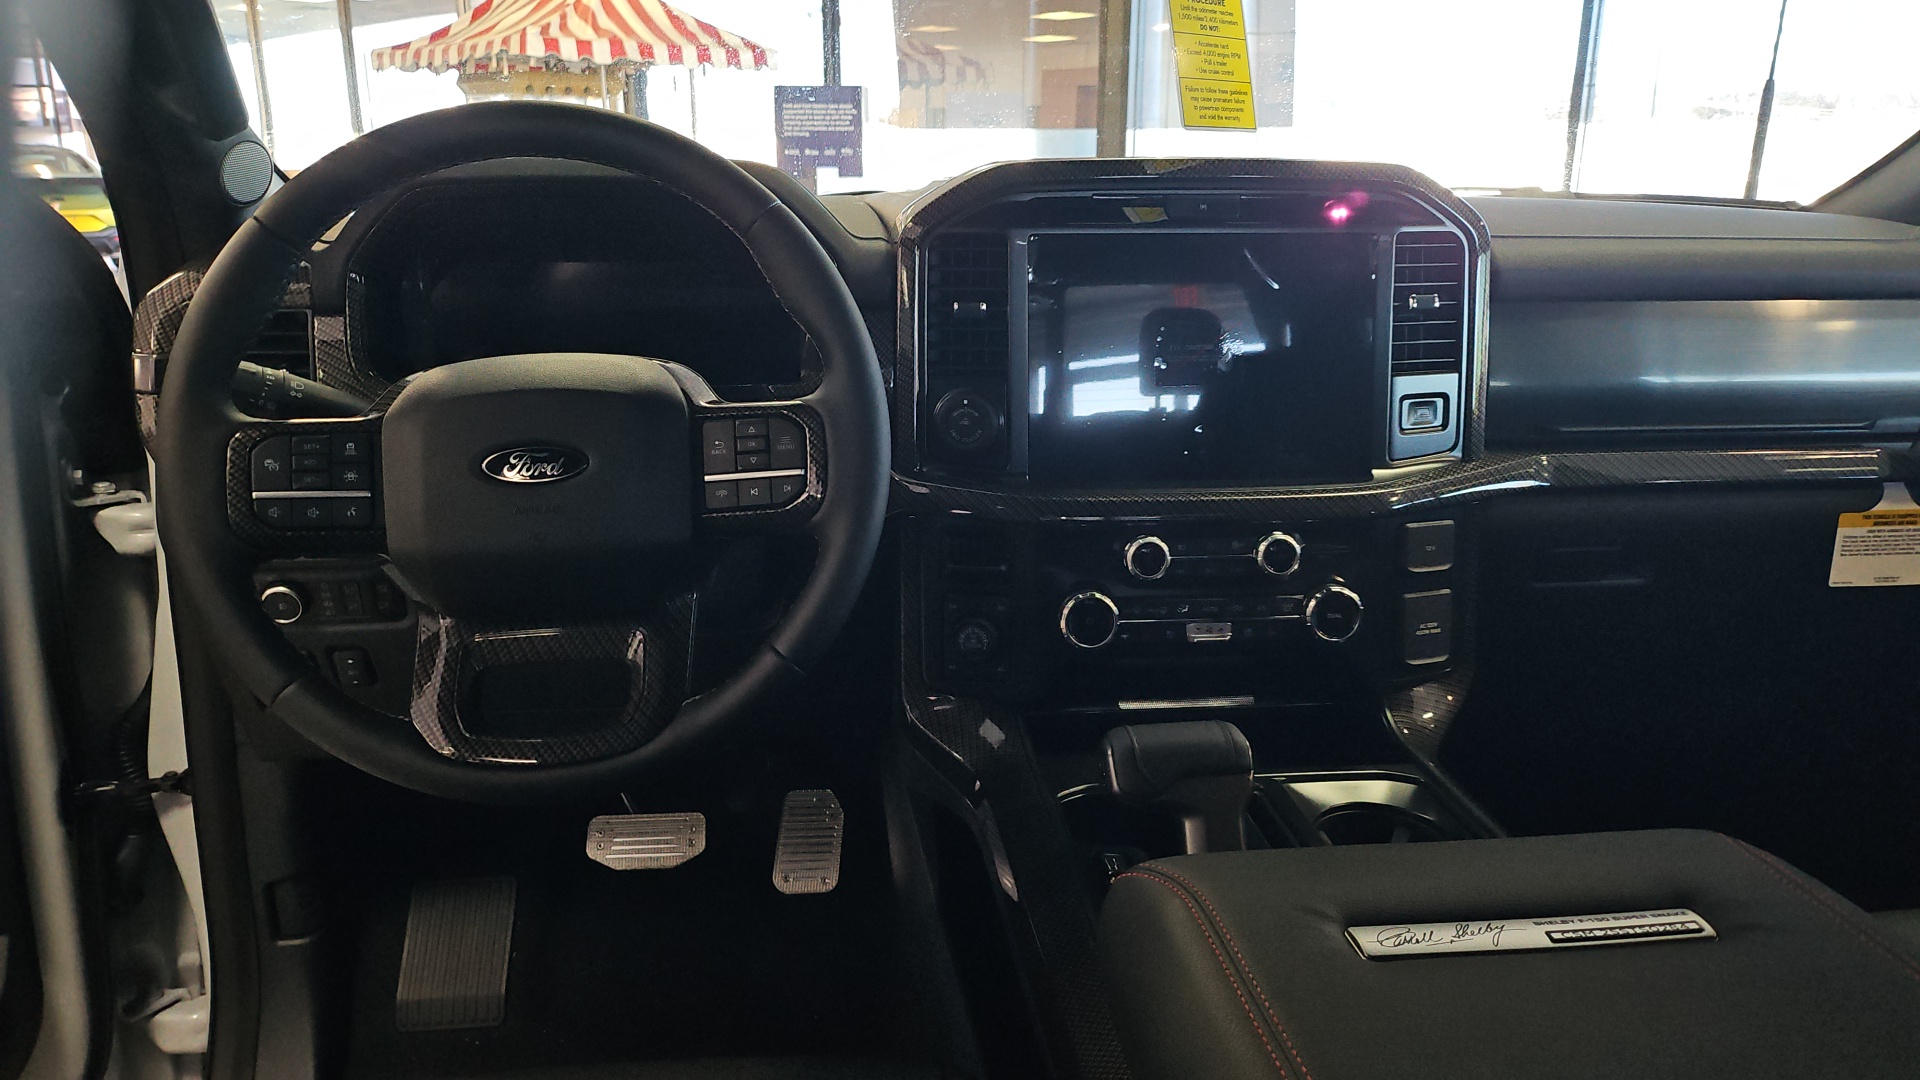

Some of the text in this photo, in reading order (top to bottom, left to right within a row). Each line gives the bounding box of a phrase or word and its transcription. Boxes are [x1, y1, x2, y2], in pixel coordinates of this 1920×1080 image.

[1186, 48, 1202, 56] Exceed
[1198, 41, 1219, 49] Accelerate
[502, 451, 565, 480] Ford
[1532, 918, 1576, 926] SHELBY
[1613, 914, 1649, 922] SUPER
[1649, 911, 1690, 919] SNAKE
[1451, 922, 1516, 947] Shelby
